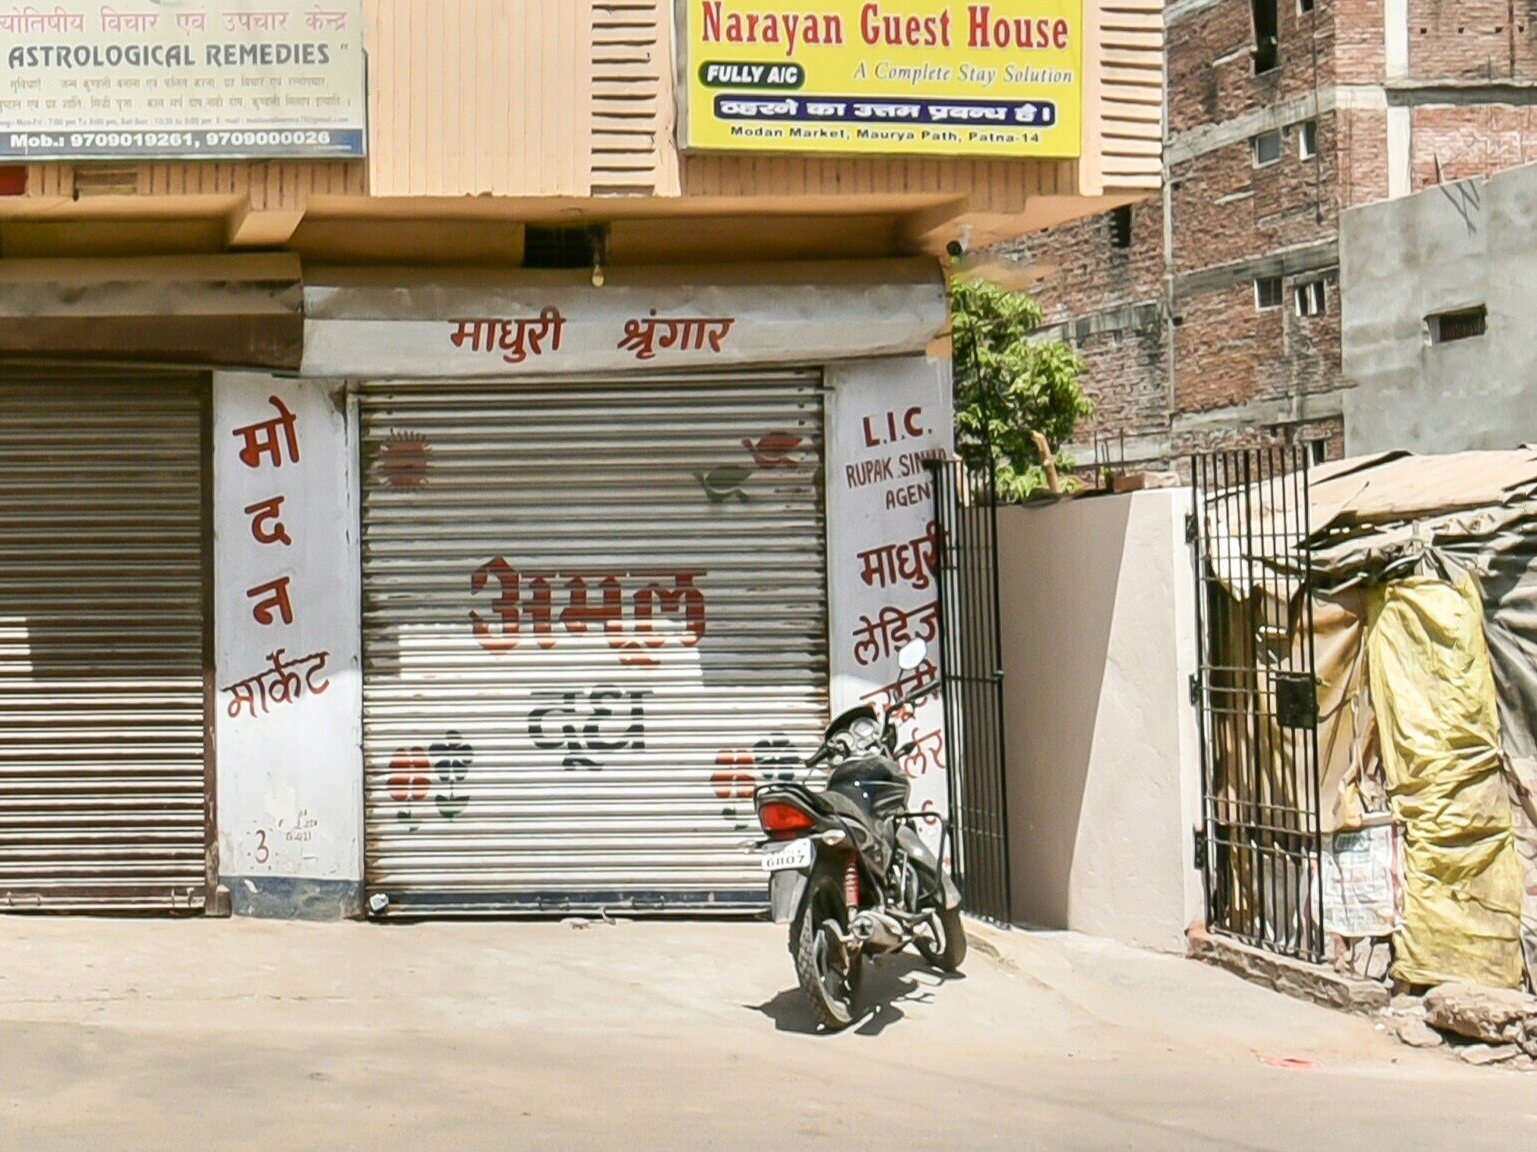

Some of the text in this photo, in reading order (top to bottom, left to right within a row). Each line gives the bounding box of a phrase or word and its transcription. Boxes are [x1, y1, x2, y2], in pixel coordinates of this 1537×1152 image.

[100, 5, 160, 34] विचार
[175, 5, 207, 37] एवं
[221, 11, 290, 34] उपचार
[304, 4, 349, 34] केन्द्र
[700, 0, 1069, 56] Narayan Guest House
[8, 43, 331, 70] ASTROLOGICAL REMEDIES
[706, 63, 765, 85] FULLY
[854, 61, 1074, 88] A Complete Stay Solution
[806, 100, 847, 118] का
[730, 125, 783, 139] Modan
[789, 127, 851, 142] Market,
[856, 129, 915, 144] Maurya
[968, 132, 1040, 145] Patna-14
[449, 305, 567, 364] माधुरी
[862, 406, 933, 448] L.I.C.
[845, 456, 894, 489] RUPAK
[885, 480, 934, 511] AGEN
[221, 649, 331, 719] मार्केट
